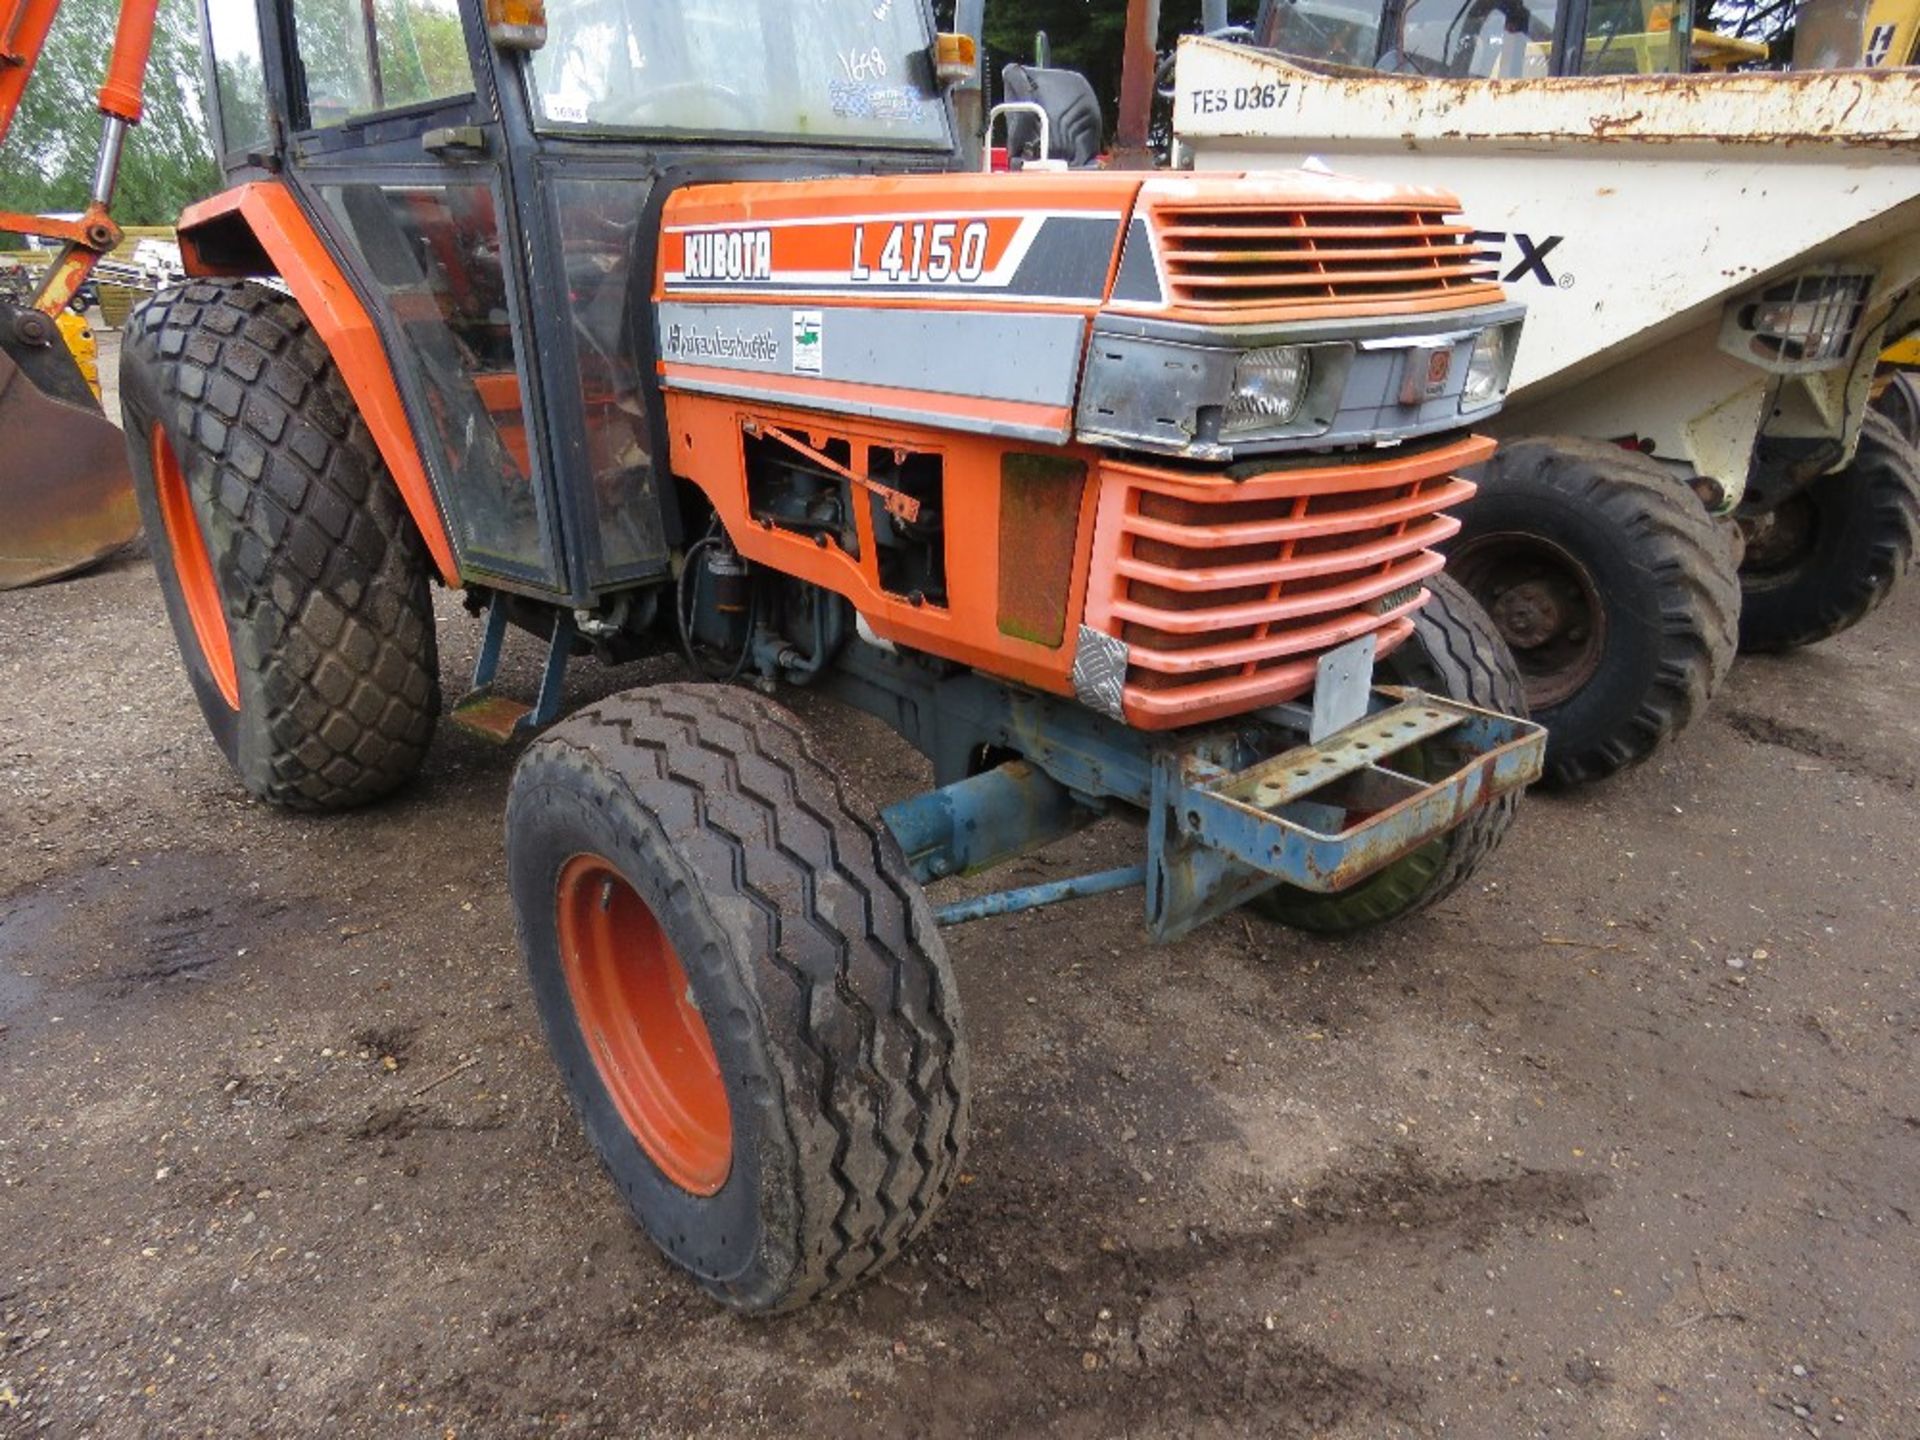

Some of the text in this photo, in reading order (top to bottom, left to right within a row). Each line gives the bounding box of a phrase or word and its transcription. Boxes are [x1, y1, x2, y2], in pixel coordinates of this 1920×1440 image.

[1191, 80, 1290, 115] TES 0367
[683, 230, 772, 281] KUBOTA
